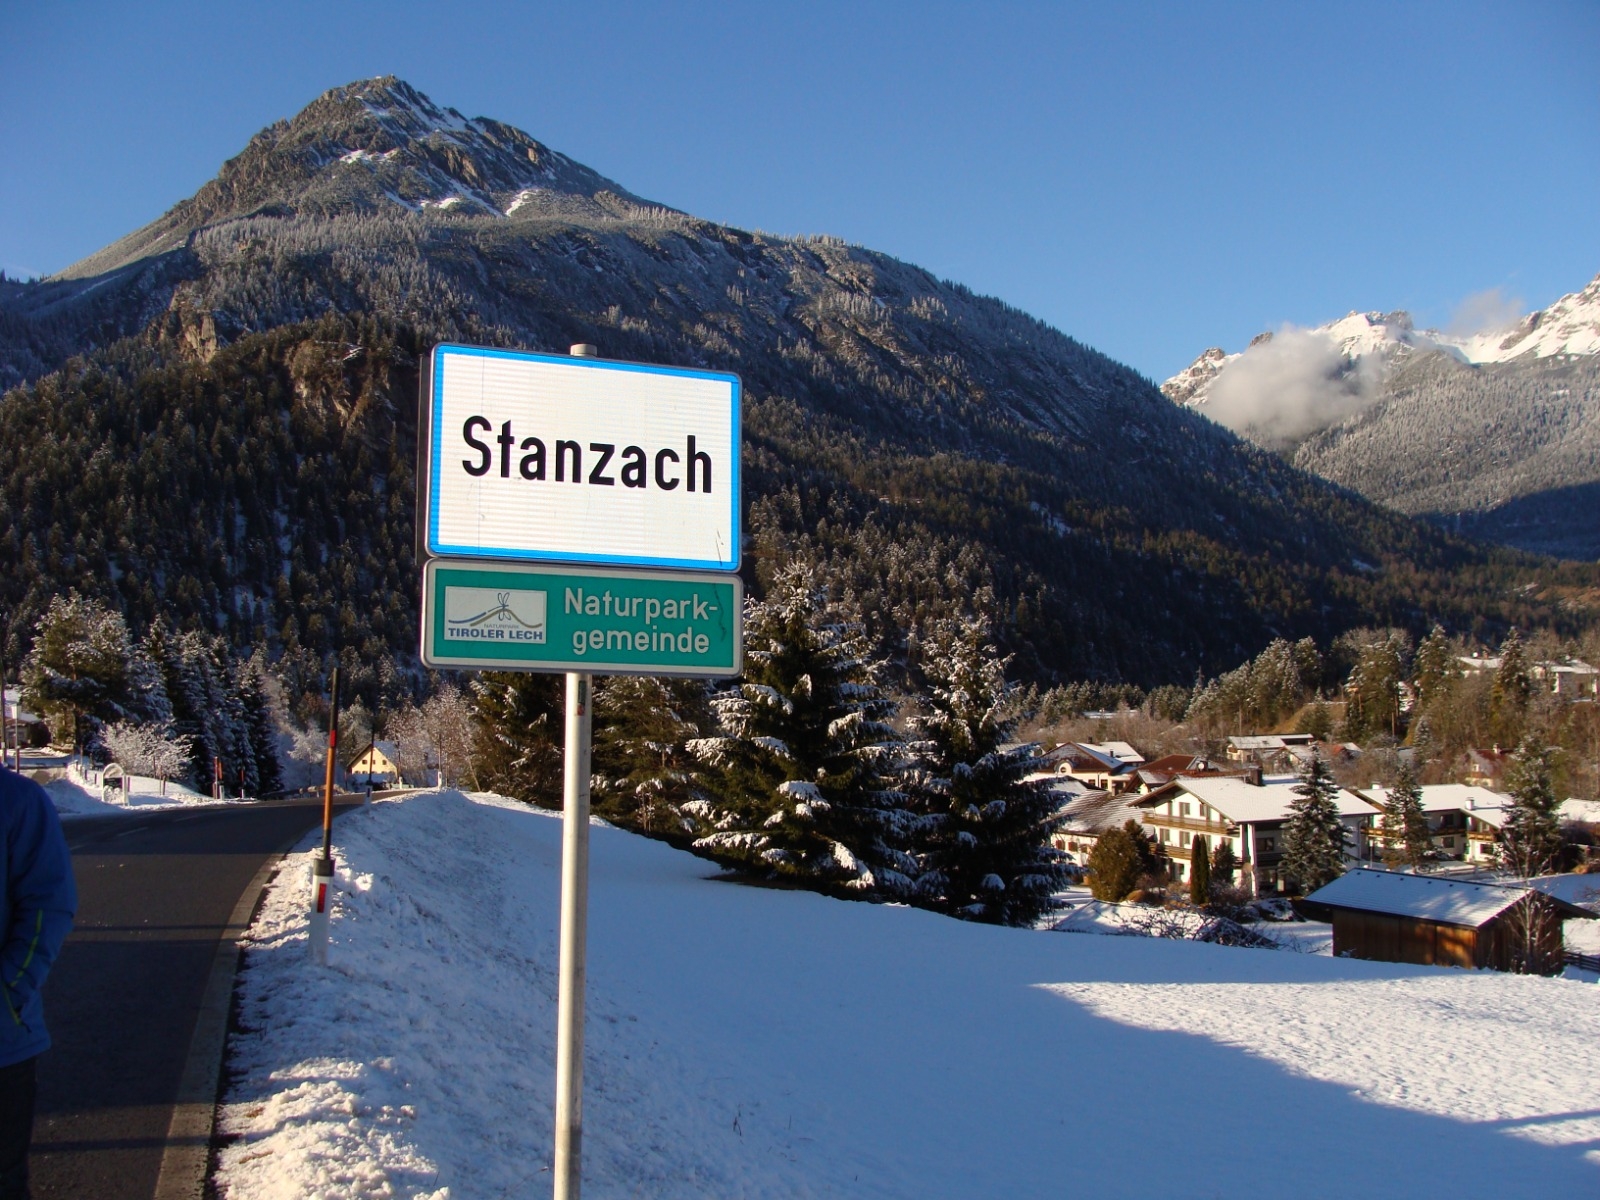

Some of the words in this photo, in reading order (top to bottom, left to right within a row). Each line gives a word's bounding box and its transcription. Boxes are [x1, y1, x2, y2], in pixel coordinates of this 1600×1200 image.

[462, 415, 712, 494] Stanzach
[565, 587, 718, 624] Naturpark-
[448, 628, 505, 639] TIROLER
[508, 630, 543, 640] LECH
[572, 625, 710, 655] gemeinde
